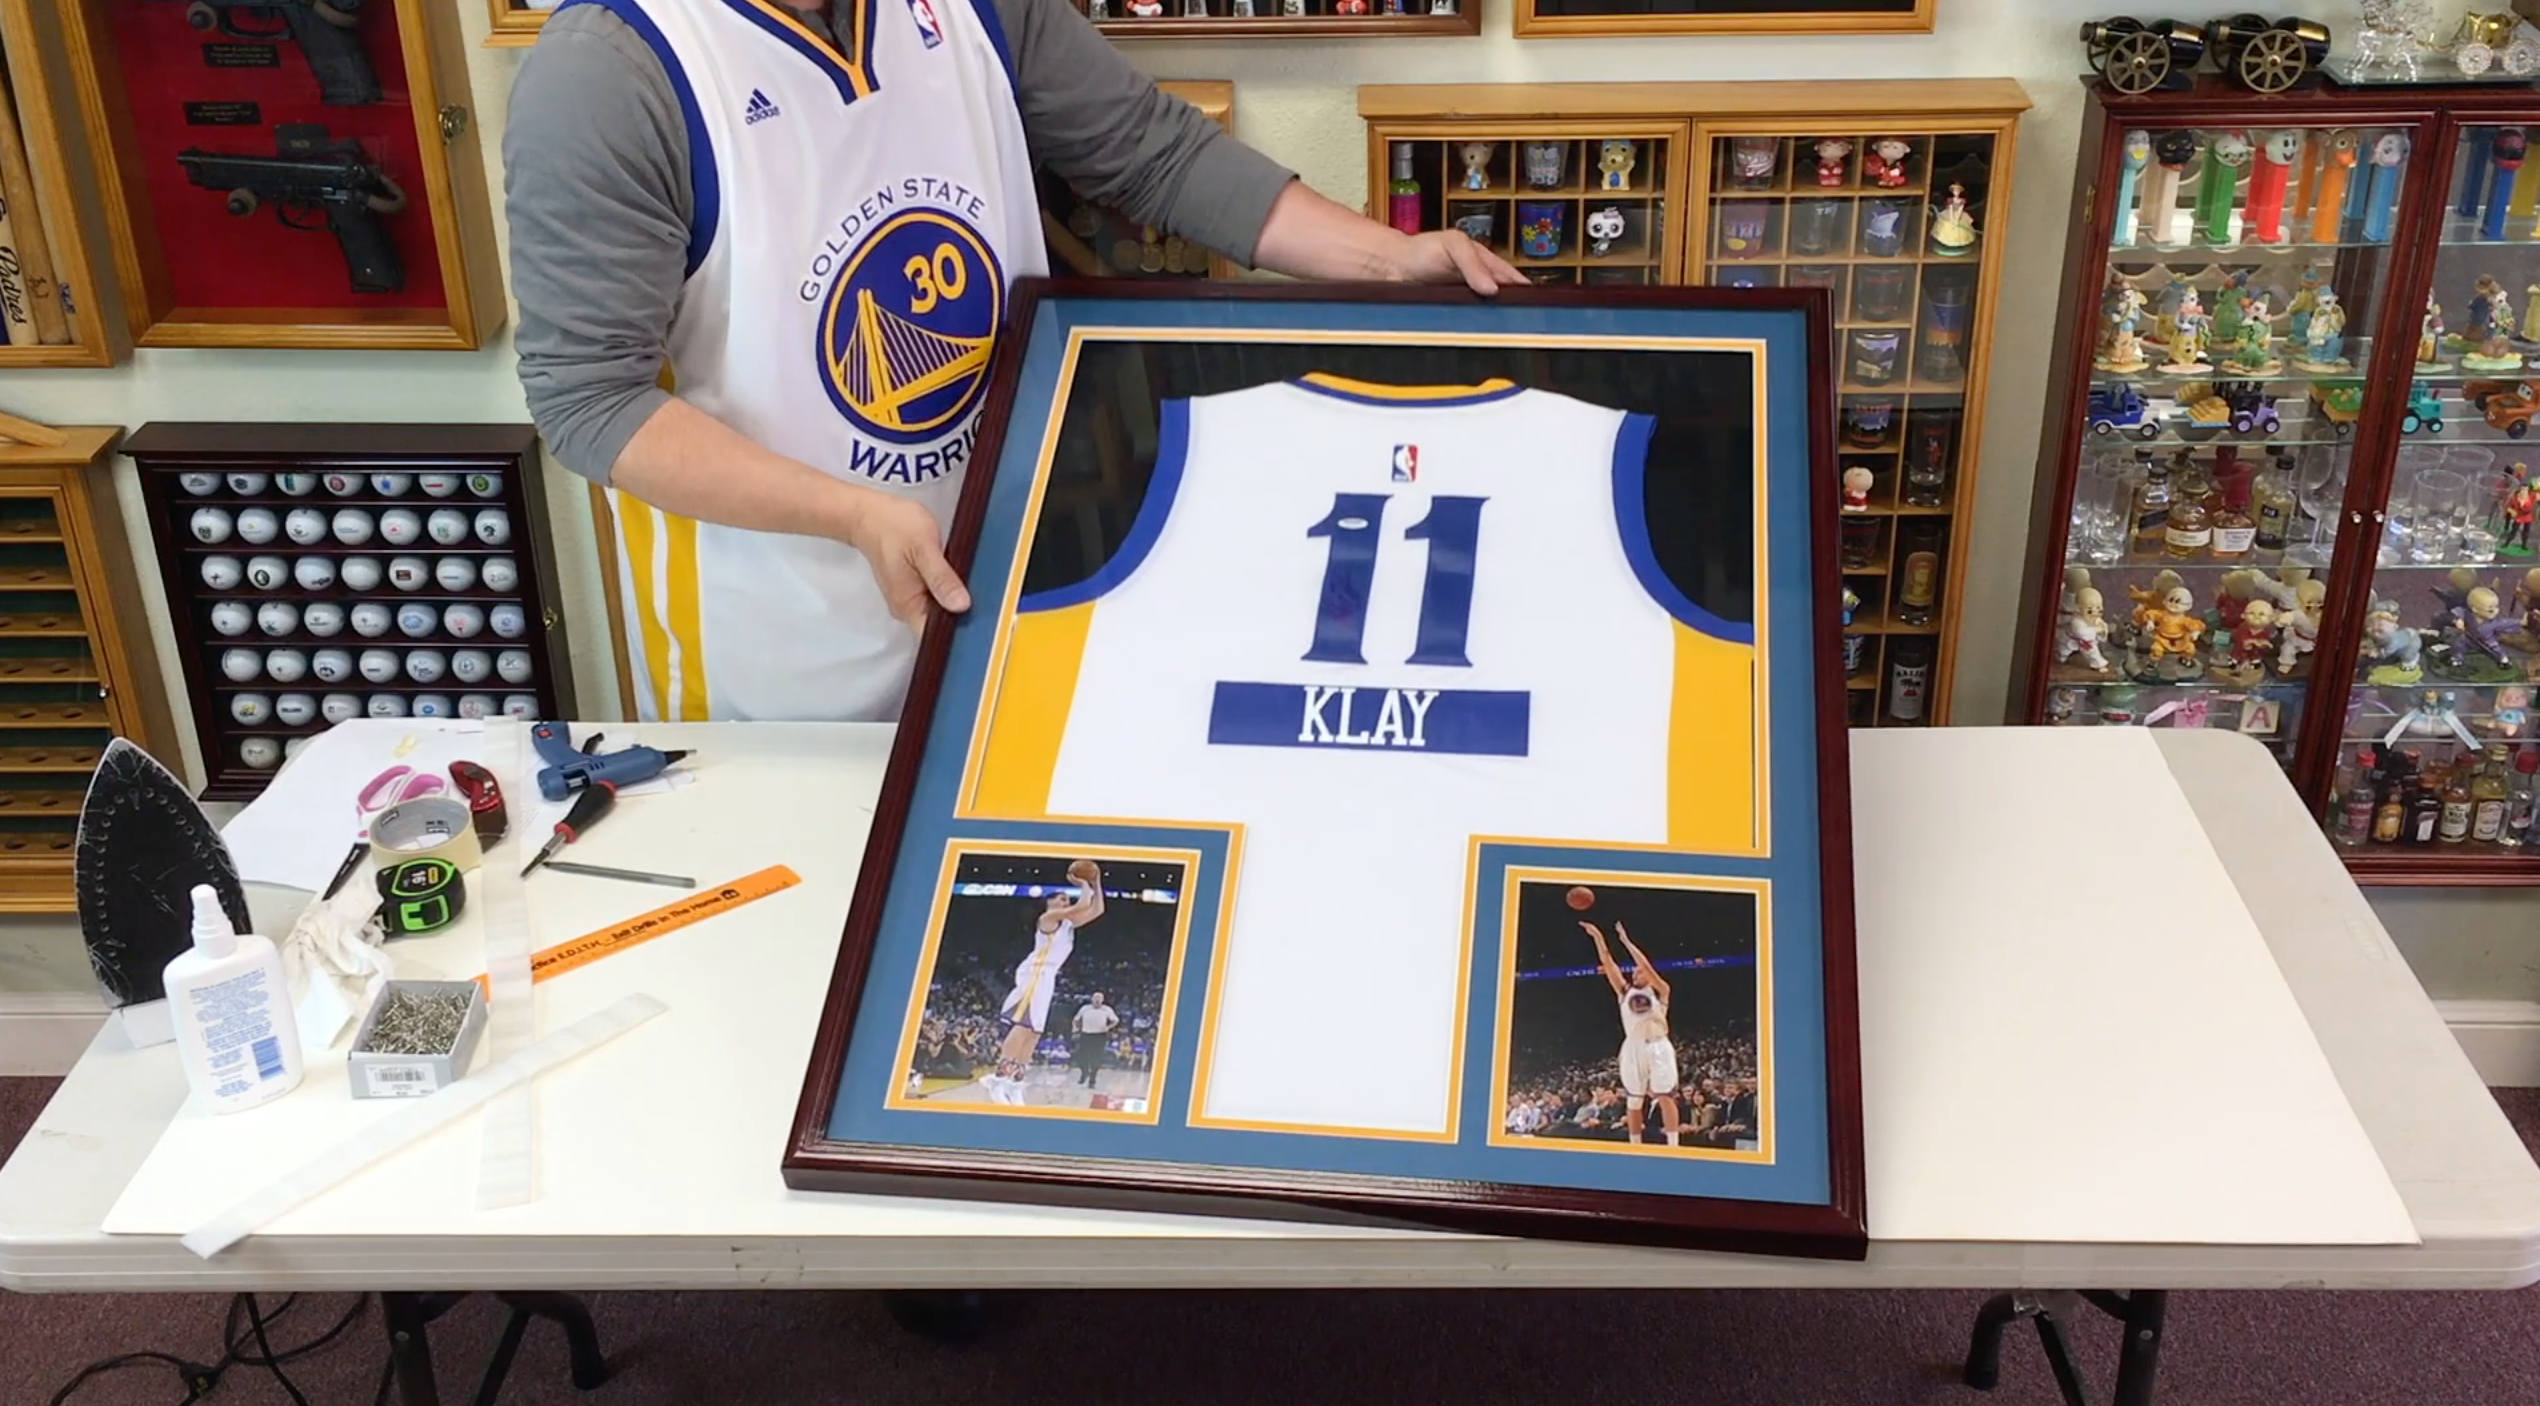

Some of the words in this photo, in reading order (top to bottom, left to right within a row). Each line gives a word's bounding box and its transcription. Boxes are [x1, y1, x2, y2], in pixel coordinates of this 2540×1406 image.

[745, 105, 780, 125] adidas
[800, 186, 894, 302] GOLDEN
[903, 177, 985, 219] STATE
[903, 242, 967, 314] 30
[1300, 492, 1491, 668] 11
[1298, 685, 1440, 747] KLAY
[2246, 705, 2271, 729] A
